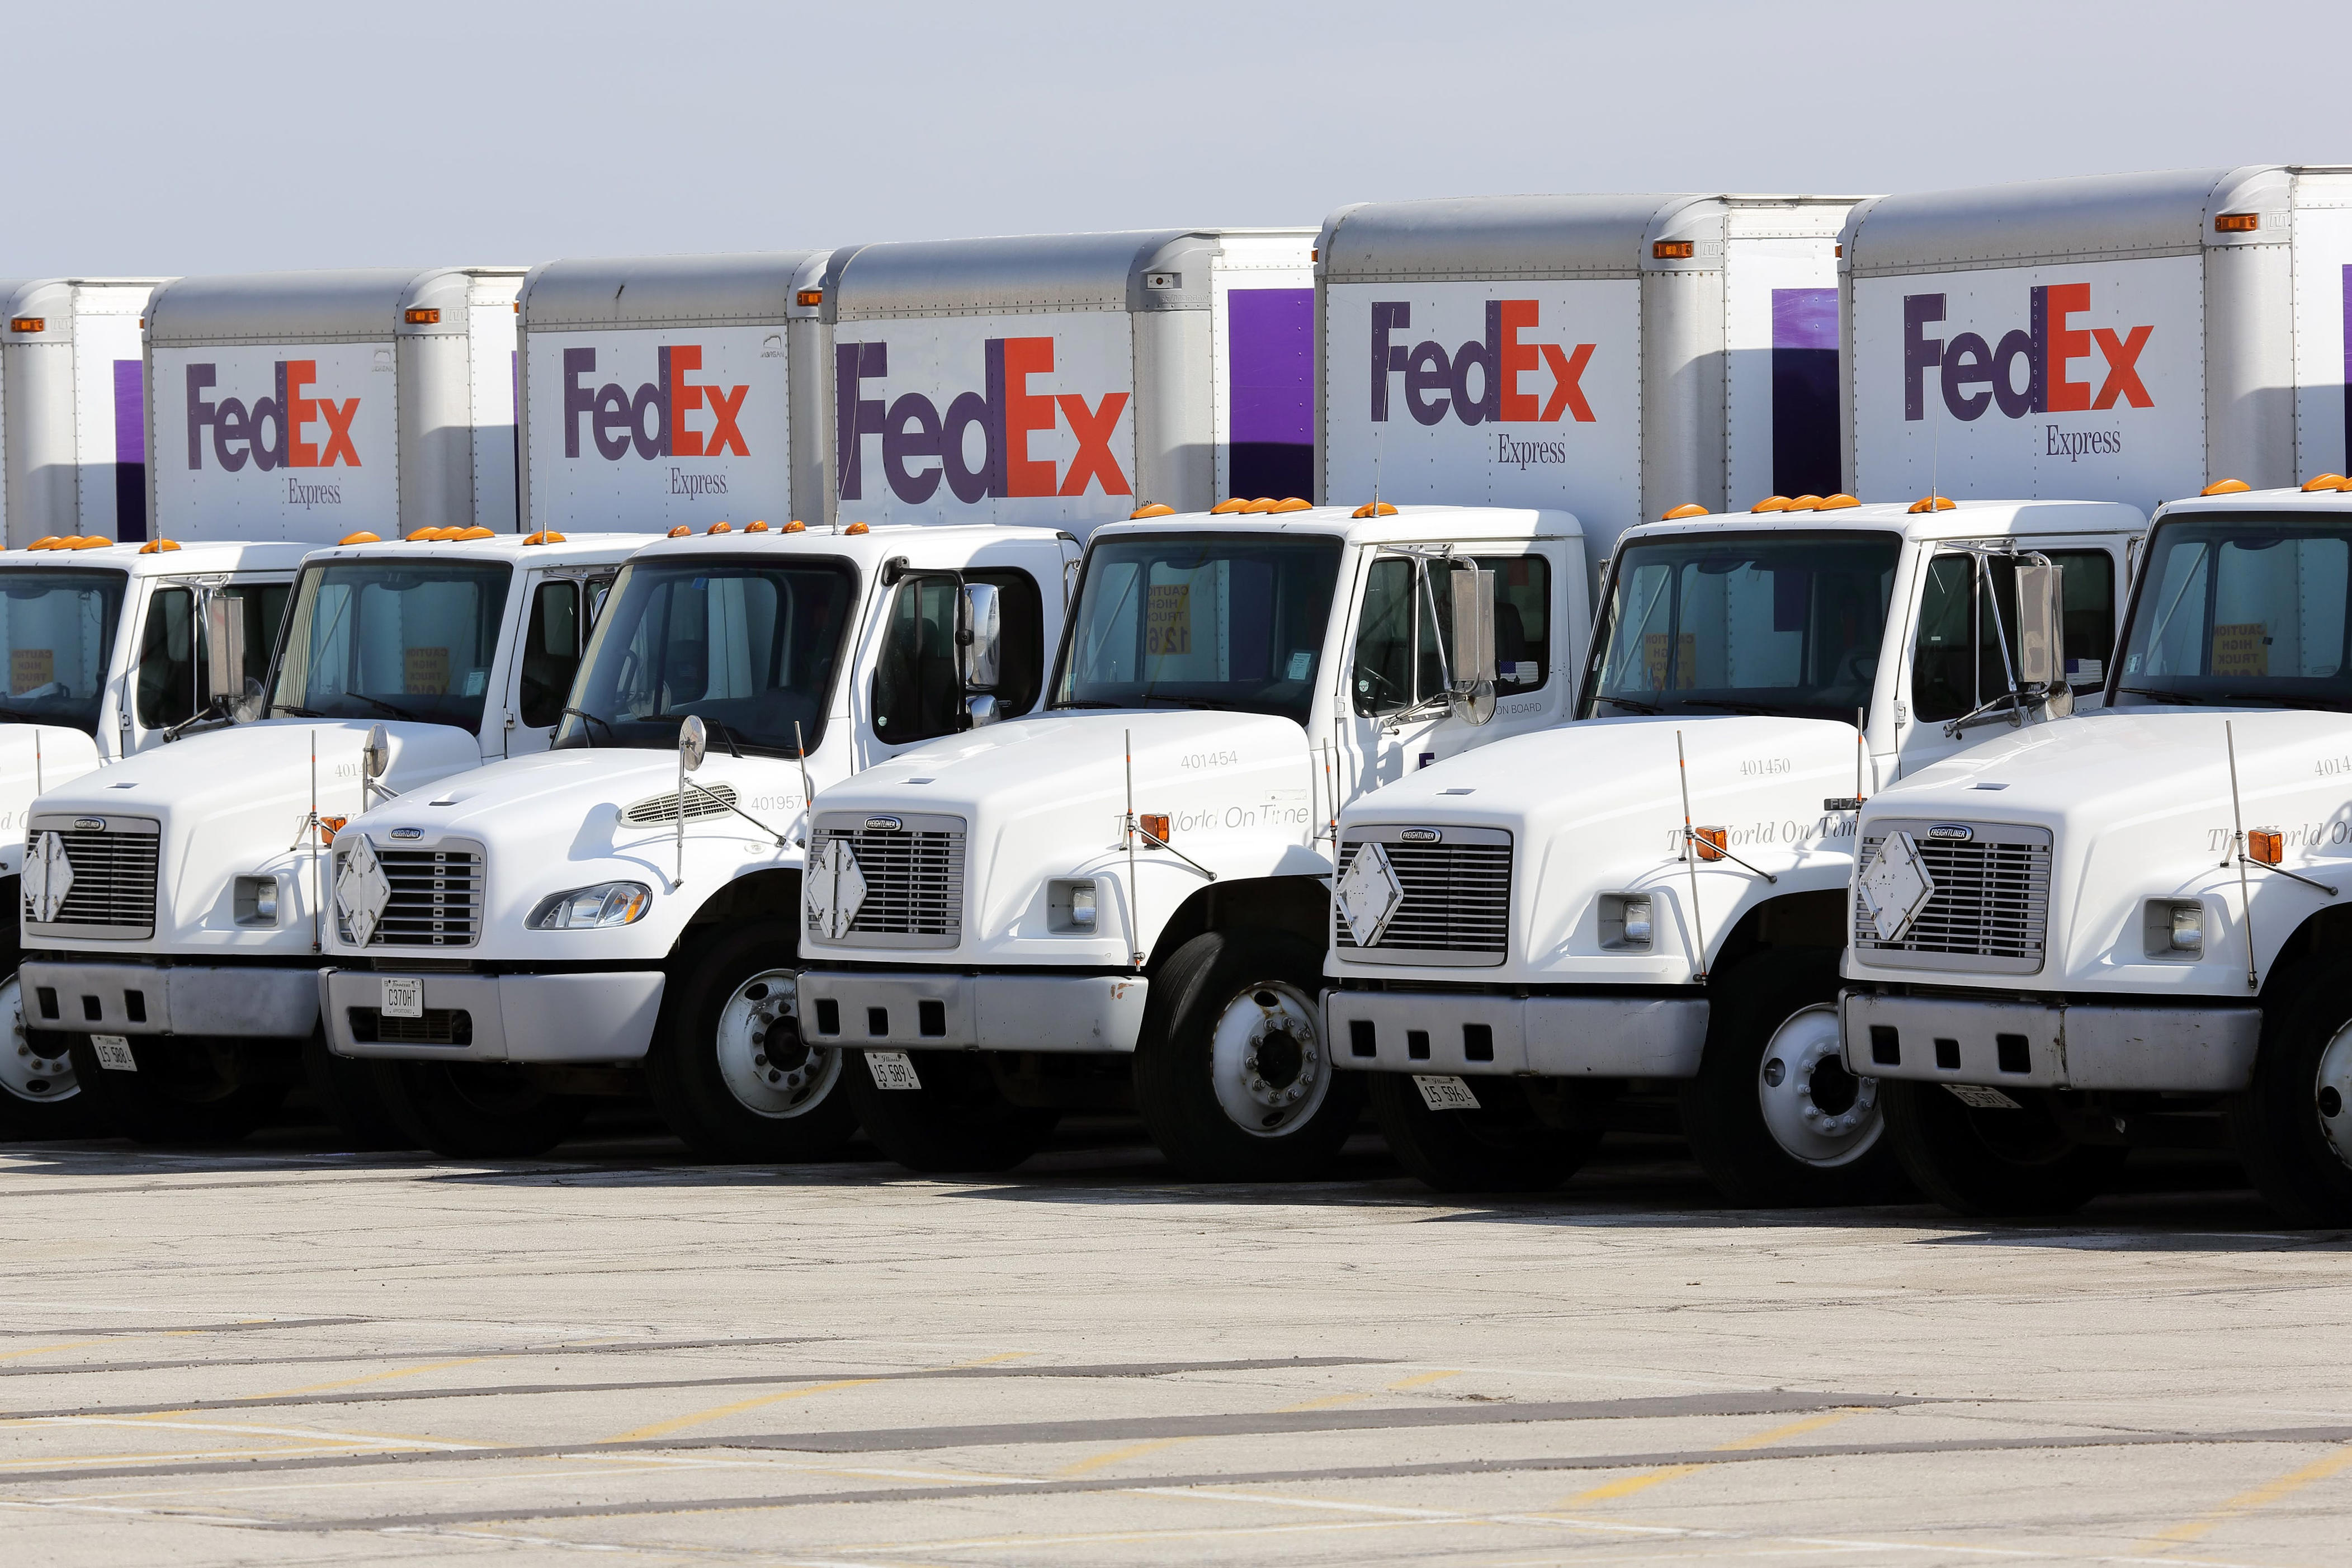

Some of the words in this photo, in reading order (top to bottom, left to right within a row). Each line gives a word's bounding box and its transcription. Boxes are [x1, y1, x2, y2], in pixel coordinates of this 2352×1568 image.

[1371, 300, 1597, 426] FedEx
[1904, 282, 2155, 421] FedEx
[564, 344, 751, 461] FedEx
[186, 360, 362, 472] FedEx
[836, 337, 1133, 504] FedEx
[1498, 433, 1566, 470] Express
[2046, 424, 2121, 462] Express
[289, 478, 341, 509] Express
[671, 467, 727, 500] Express
[1496, 706, 1509, 715] ON
[1512, 702, 1542, 714] BOARD
[1181, 750, 1238, 769] 401454
[1740, 758, 1791, 776] 401450
[2314, 755, 2352, 776] 4014
[751, 795, 803, 810] 401957
[1225, 807, 1255, 828] On
[1260, 804, 1309, 825] Time
[1725, 821, 1776, 846] orld
[1782, 821, 1812, 843] On
[1819, 815, 1857, 838] Tim
[1930, 828, 1966, 837] FREIGHTLINER
[389, 989, 416, 1007] C370HT
[98, 1046, 111, 1062] 15
[110, 1047, 127, 1064] 588
[874, 1064, 887, 1082] 15
[887, 1064, 906, 1082] 589
[1424, 1086, 1442, 1102] 15
[1441, 1086, 1465, 1102] 596
